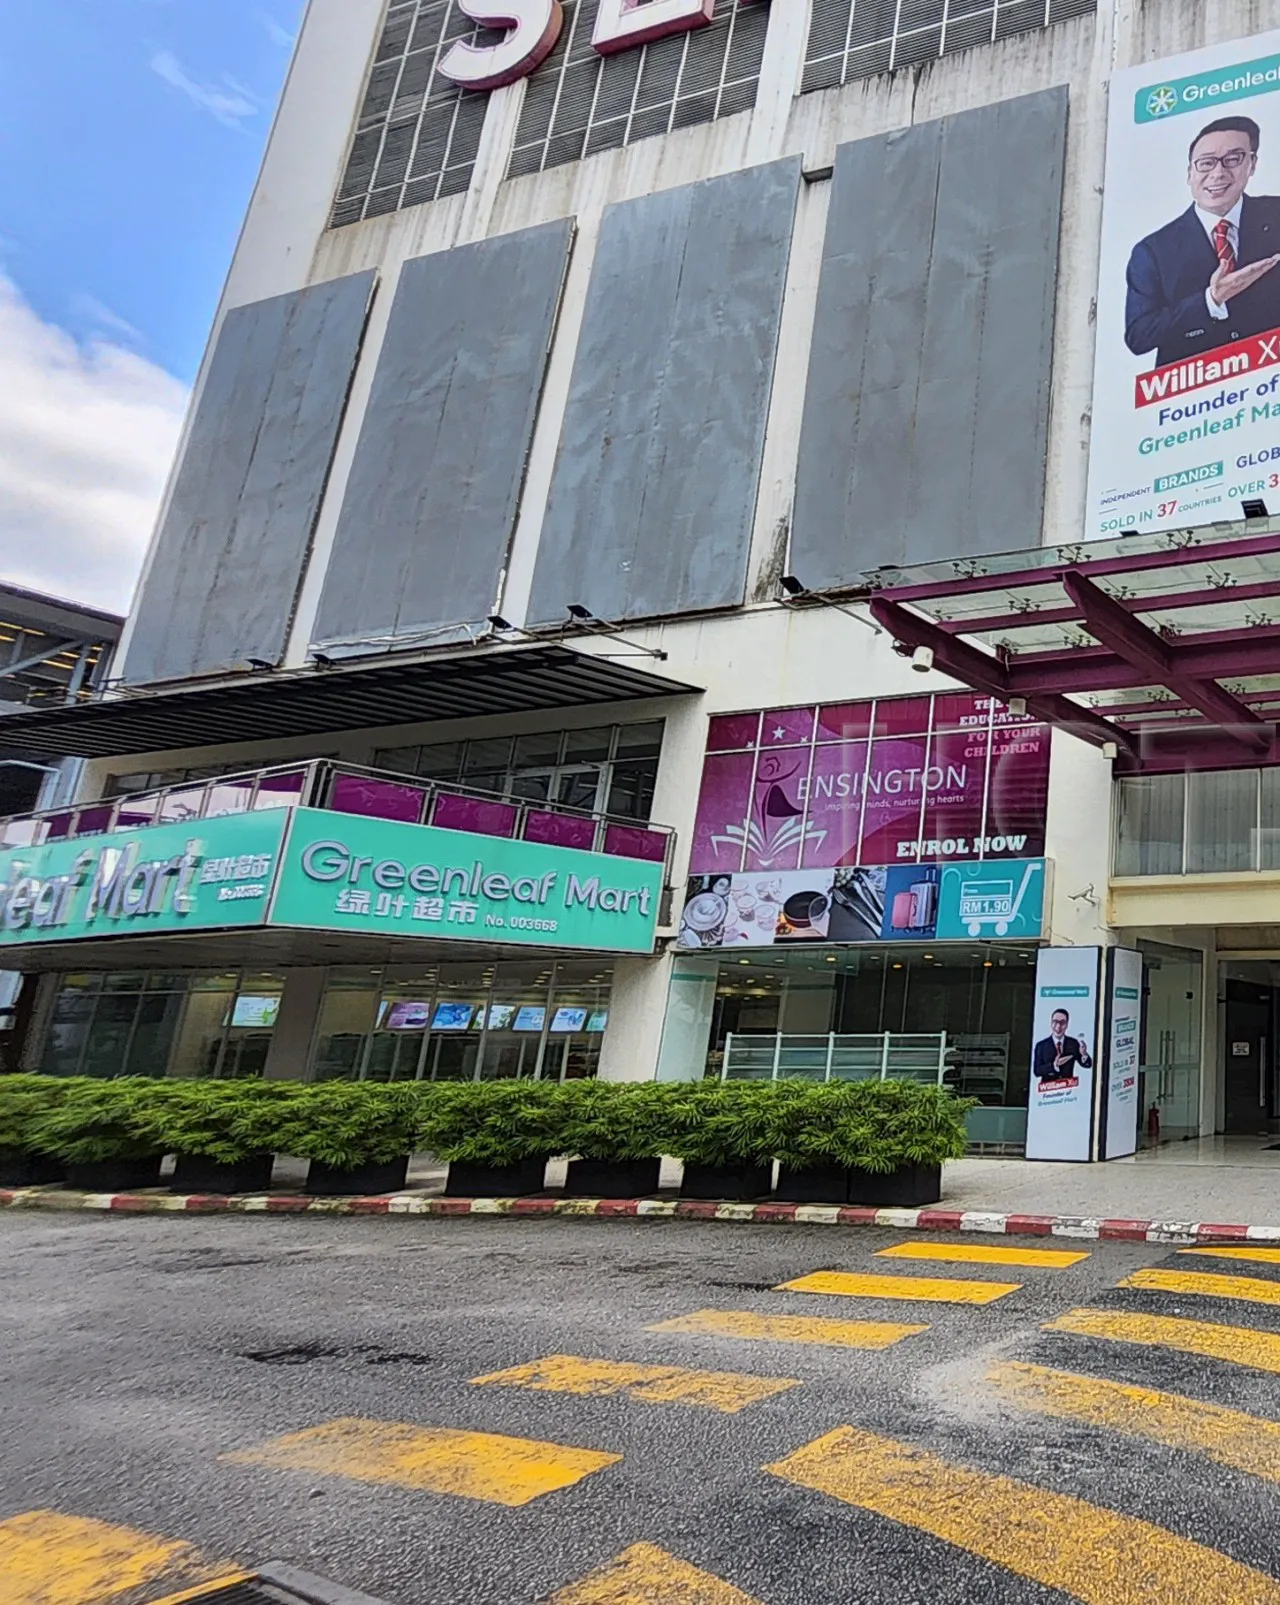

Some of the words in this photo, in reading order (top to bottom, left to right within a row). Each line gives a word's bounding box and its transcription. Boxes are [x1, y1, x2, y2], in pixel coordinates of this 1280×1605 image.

[1140, 352, 1249, 401] William
[1159, 389, 1249, 426] Founder
[1256, 374, 1280, 396] of
[1138, 409, 1246, 455] Greenleaf
[1100, 487, 1151, 506] INDEPENDENT
[1159, 464, 1219, 491] BRANDS
[1228, 480, 1265, 498] OVER
[1100, 515, 1136, 532] SOLD
[1139, 509, 1153, 523] IN
[1157, 500, 1177, 518] 37
[1178, 495, 1222, 513] COUNTRIES
[1003, 727, 1040, 740] YOUR
[937, 794, 964, 804] hearts
[896, 837, 970, 859] ENROL
[973, 835, 1028, 852] NOW
[302, 840, 558, 905] Greenleaf
[565, 873, 652, 916] Mart
[335, 889, 479, 923] 绿叶超市
